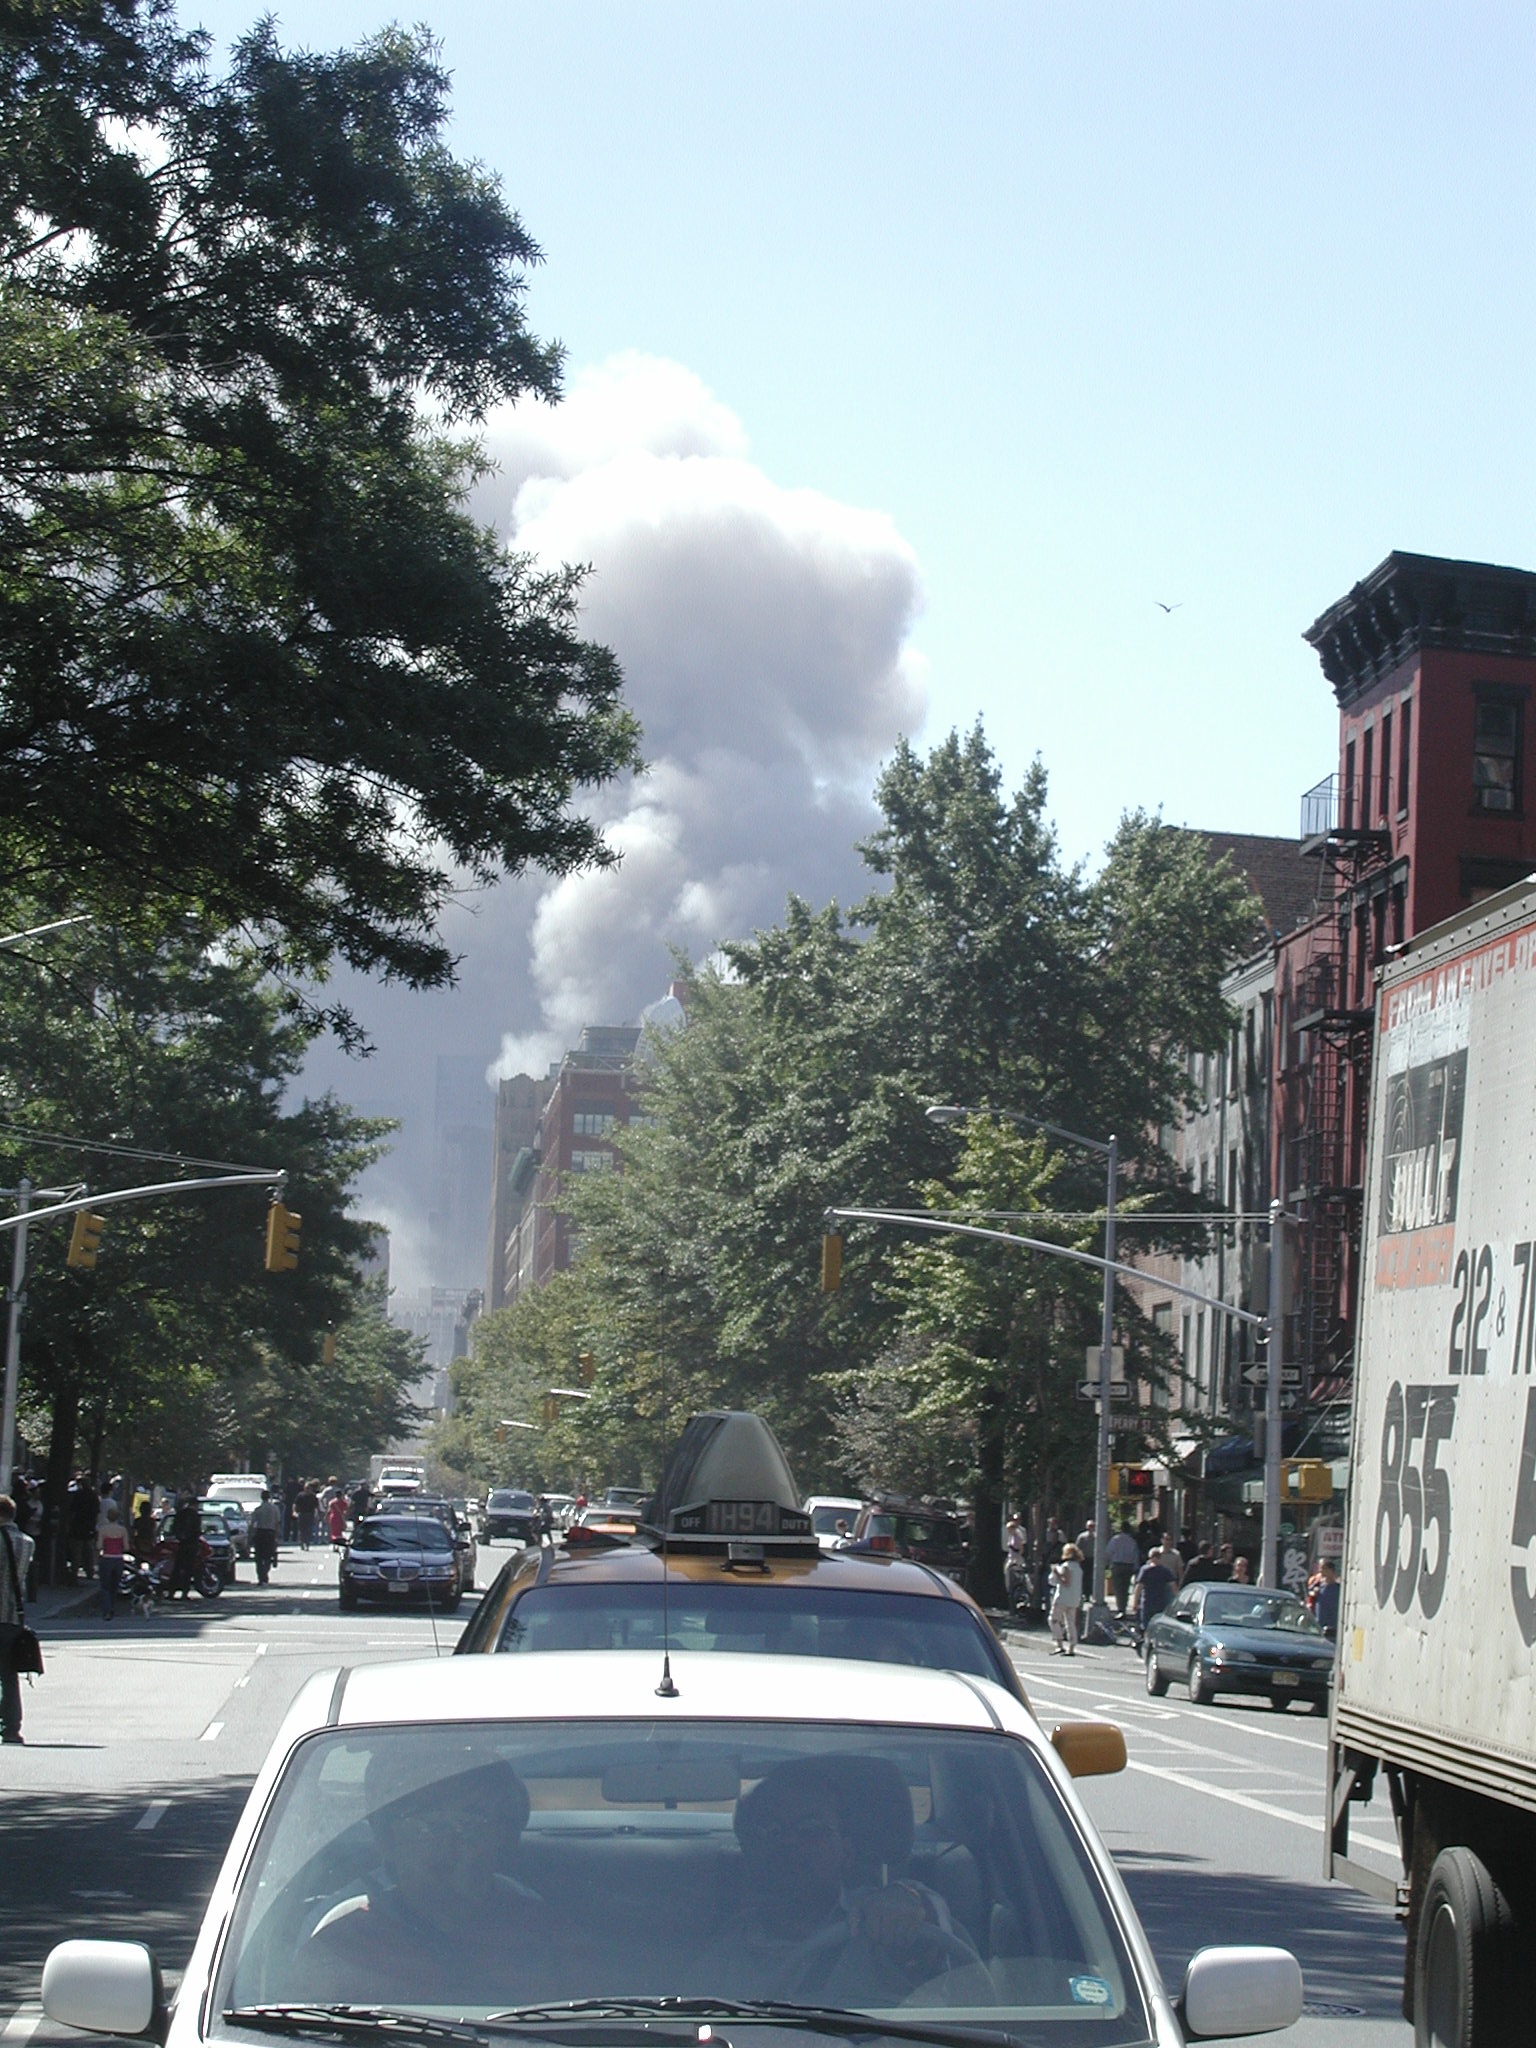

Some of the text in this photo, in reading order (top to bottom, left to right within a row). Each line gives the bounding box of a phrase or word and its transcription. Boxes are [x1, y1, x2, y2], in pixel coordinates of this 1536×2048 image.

[1388, 976, 1432, 1030] FROM
[1435, 965, 1460, 1006] AN
[1448, 1240, 1536, 1376] 212 & 71
[681, 1516, 701, 1528] OFF
[781, 1519, 810, 1530] DUTY
[1374, 1380, 1459, 1620] 855
